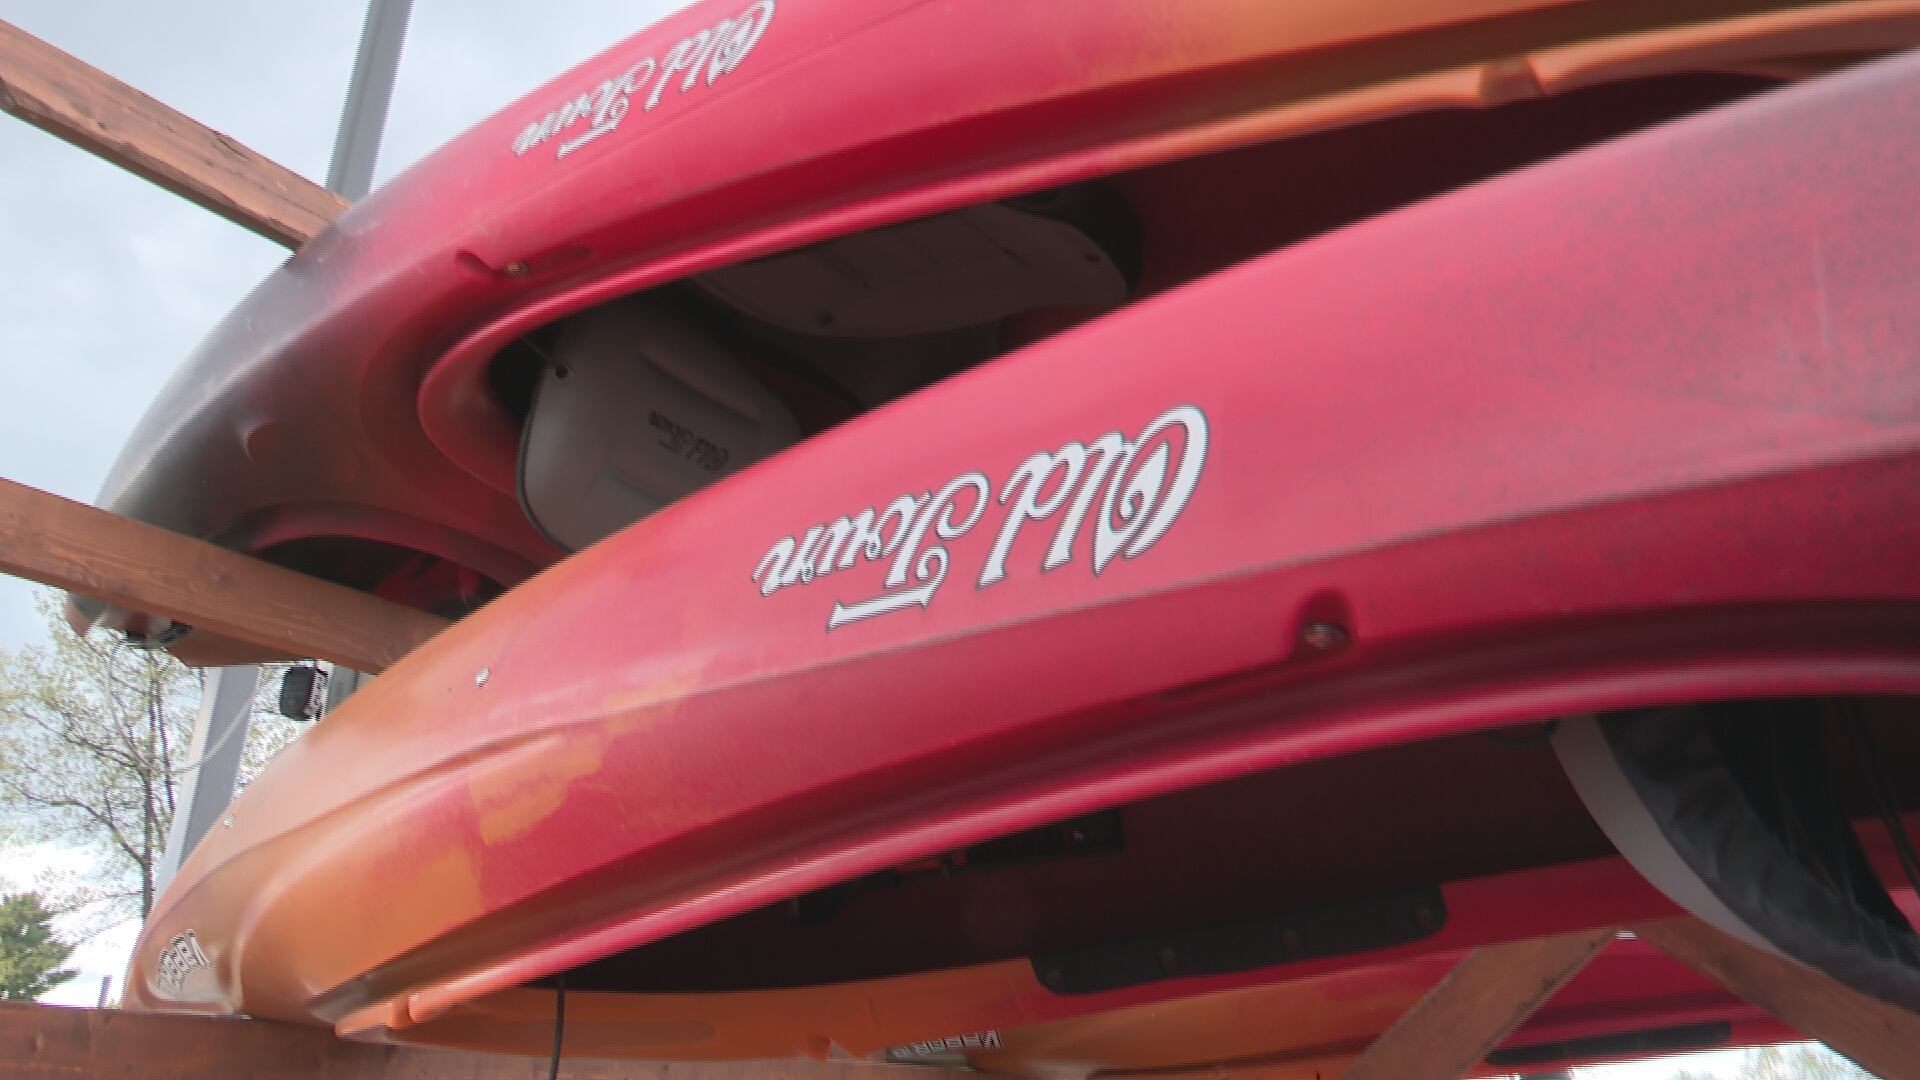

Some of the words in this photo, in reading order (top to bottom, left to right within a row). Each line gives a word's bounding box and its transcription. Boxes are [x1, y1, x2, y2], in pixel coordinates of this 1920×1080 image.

[510, 56, 656, 160] Town
[641, 0, 776, 112] Old
[751, 472, 991, 632] Town
[975, 404, 1210, 590] Old
